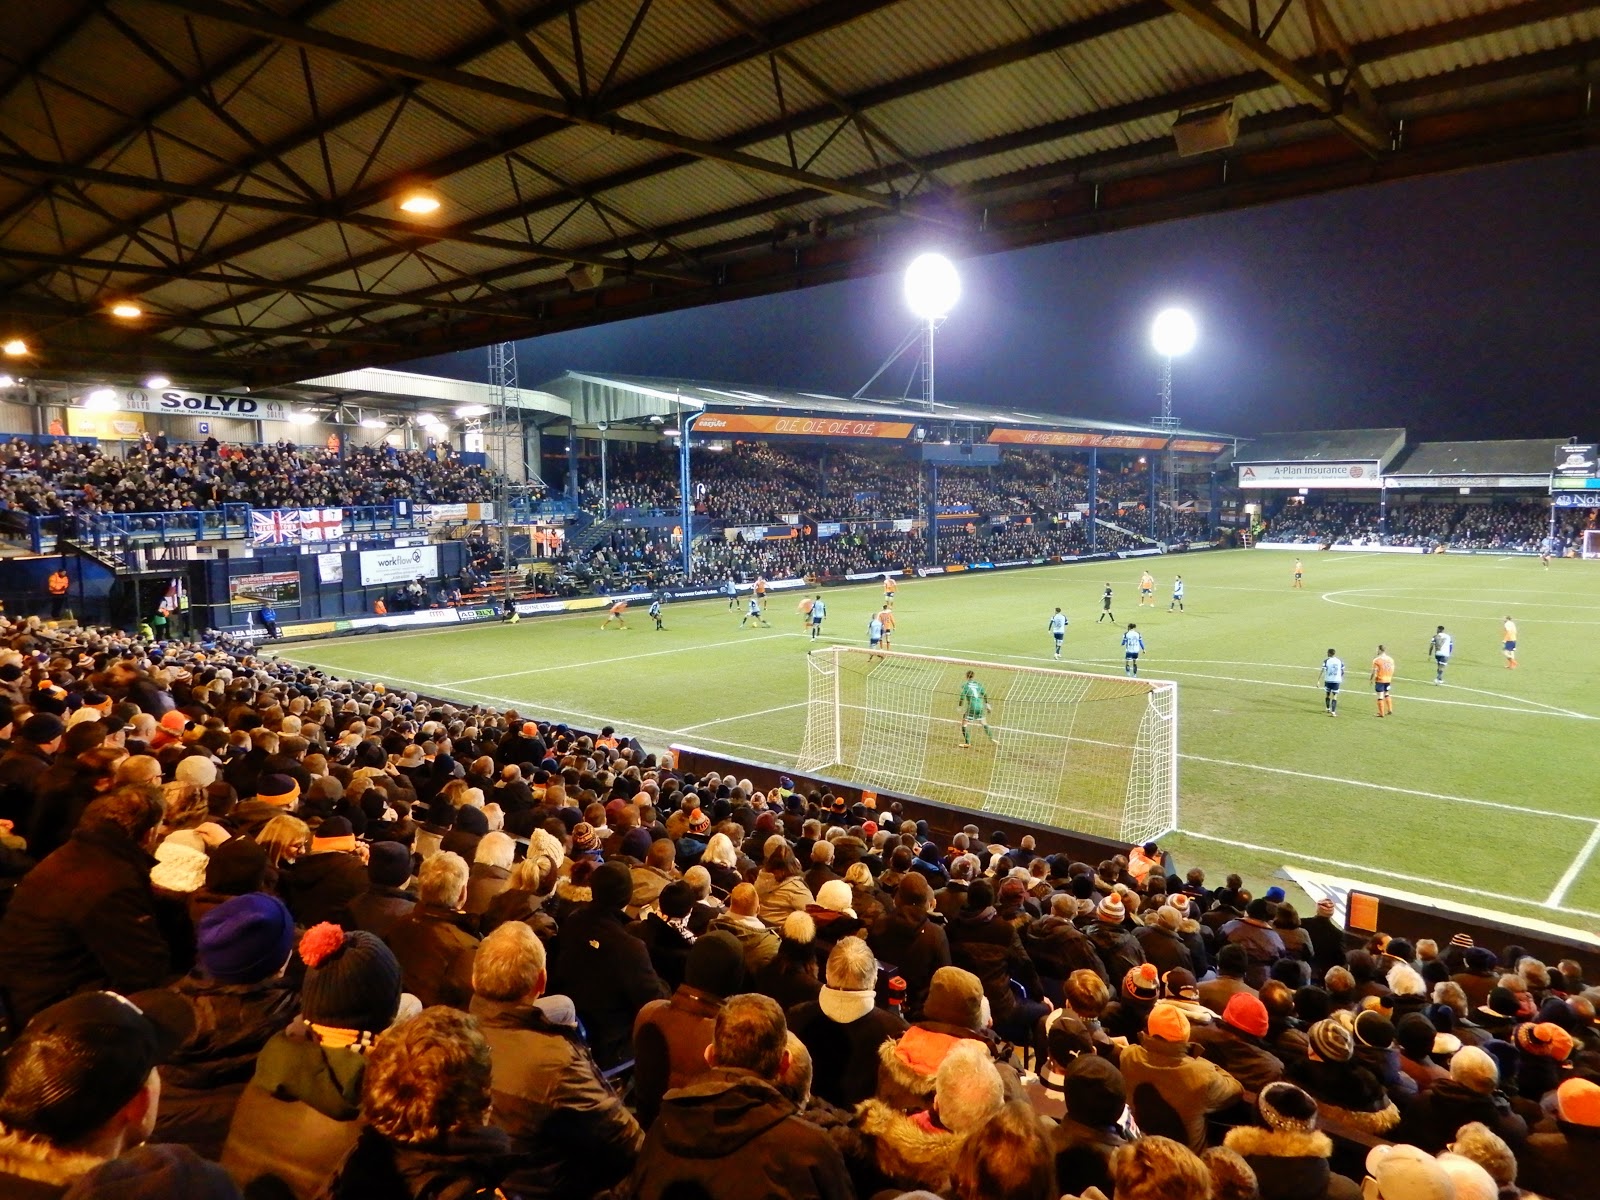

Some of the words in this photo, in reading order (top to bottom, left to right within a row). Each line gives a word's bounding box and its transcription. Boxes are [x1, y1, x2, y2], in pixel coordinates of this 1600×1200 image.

[160, 393, 257, 413] SoLYD
[200, 424, 207, 432] C
[699, 420, 727, 428] easyJet
[1024, 433, 1037, 442] WE
[1039, 433, 1052, 443] ARE
[1052, 434, 1065, 443] THE
[1066, 435, 1086, 444] TOWN
[1274, 466, 1302, 475] A-Plan
[1304, 466, 1348, 474] Insurance
[1441, 477, 1488, 485] STORAGE
[377, 555, 413, 567] workflow
[245, 628, 269, 636] BOXES
